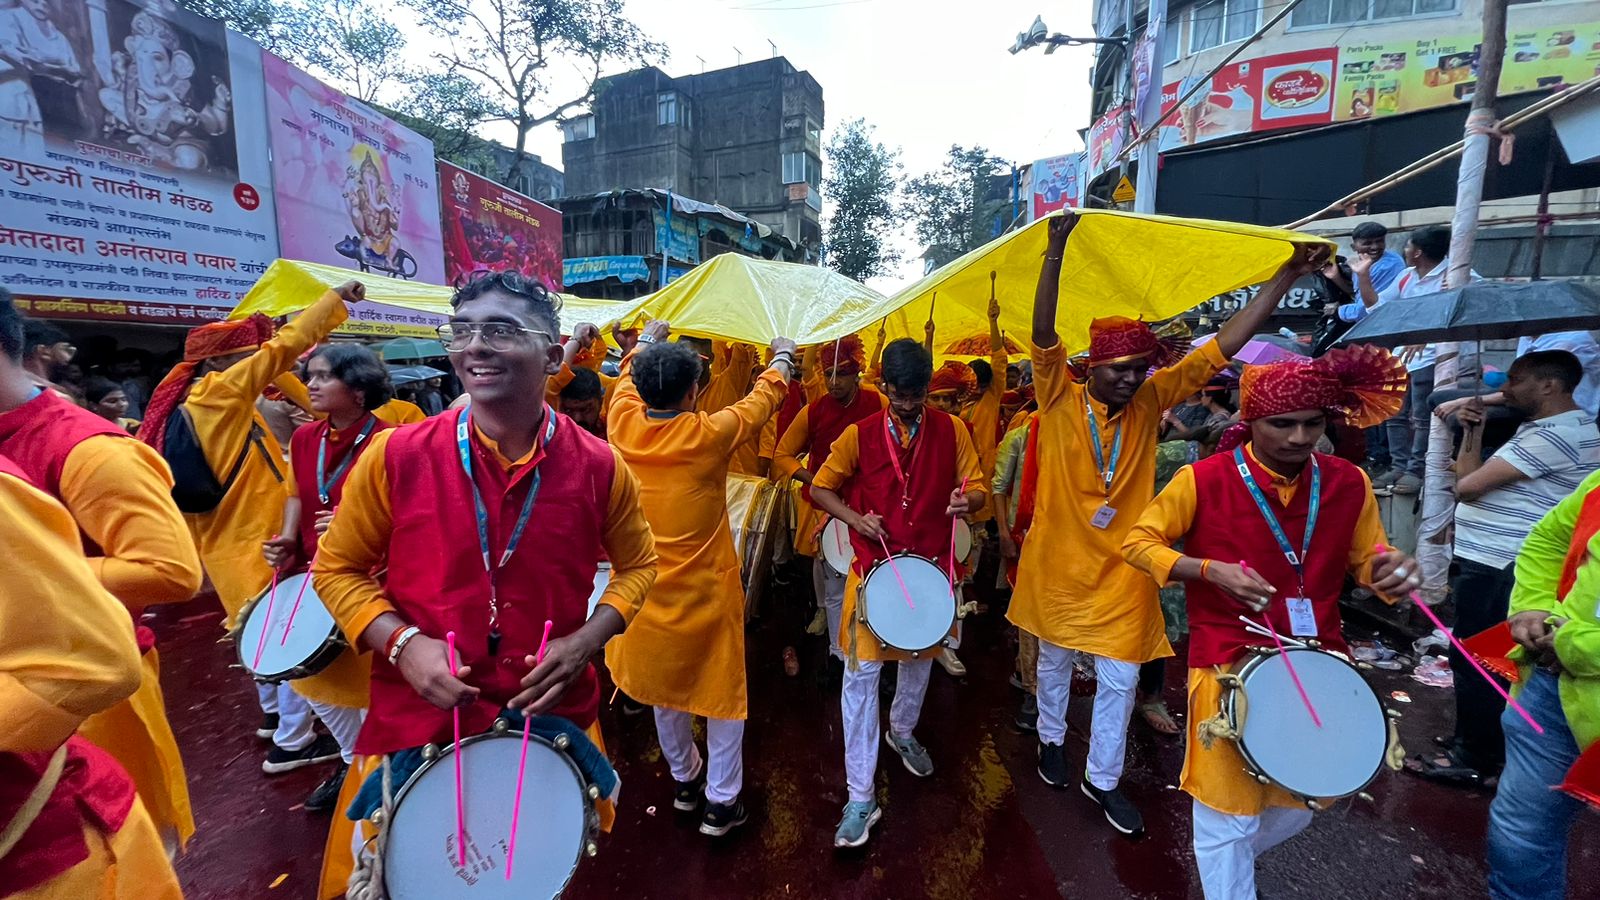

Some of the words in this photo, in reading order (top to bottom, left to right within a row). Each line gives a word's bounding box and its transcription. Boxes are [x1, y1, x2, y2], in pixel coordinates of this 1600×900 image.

[1437, 46, 1457, 54] FREE
[90, 175, 162, 204] तालीम
[167, 188, 214, 214] मंडळ
[45, 211, 100, 231] मंडळाचे
[95, 238, 188, 267] अनंतराव
[193, 253, 237, 273] पवार
